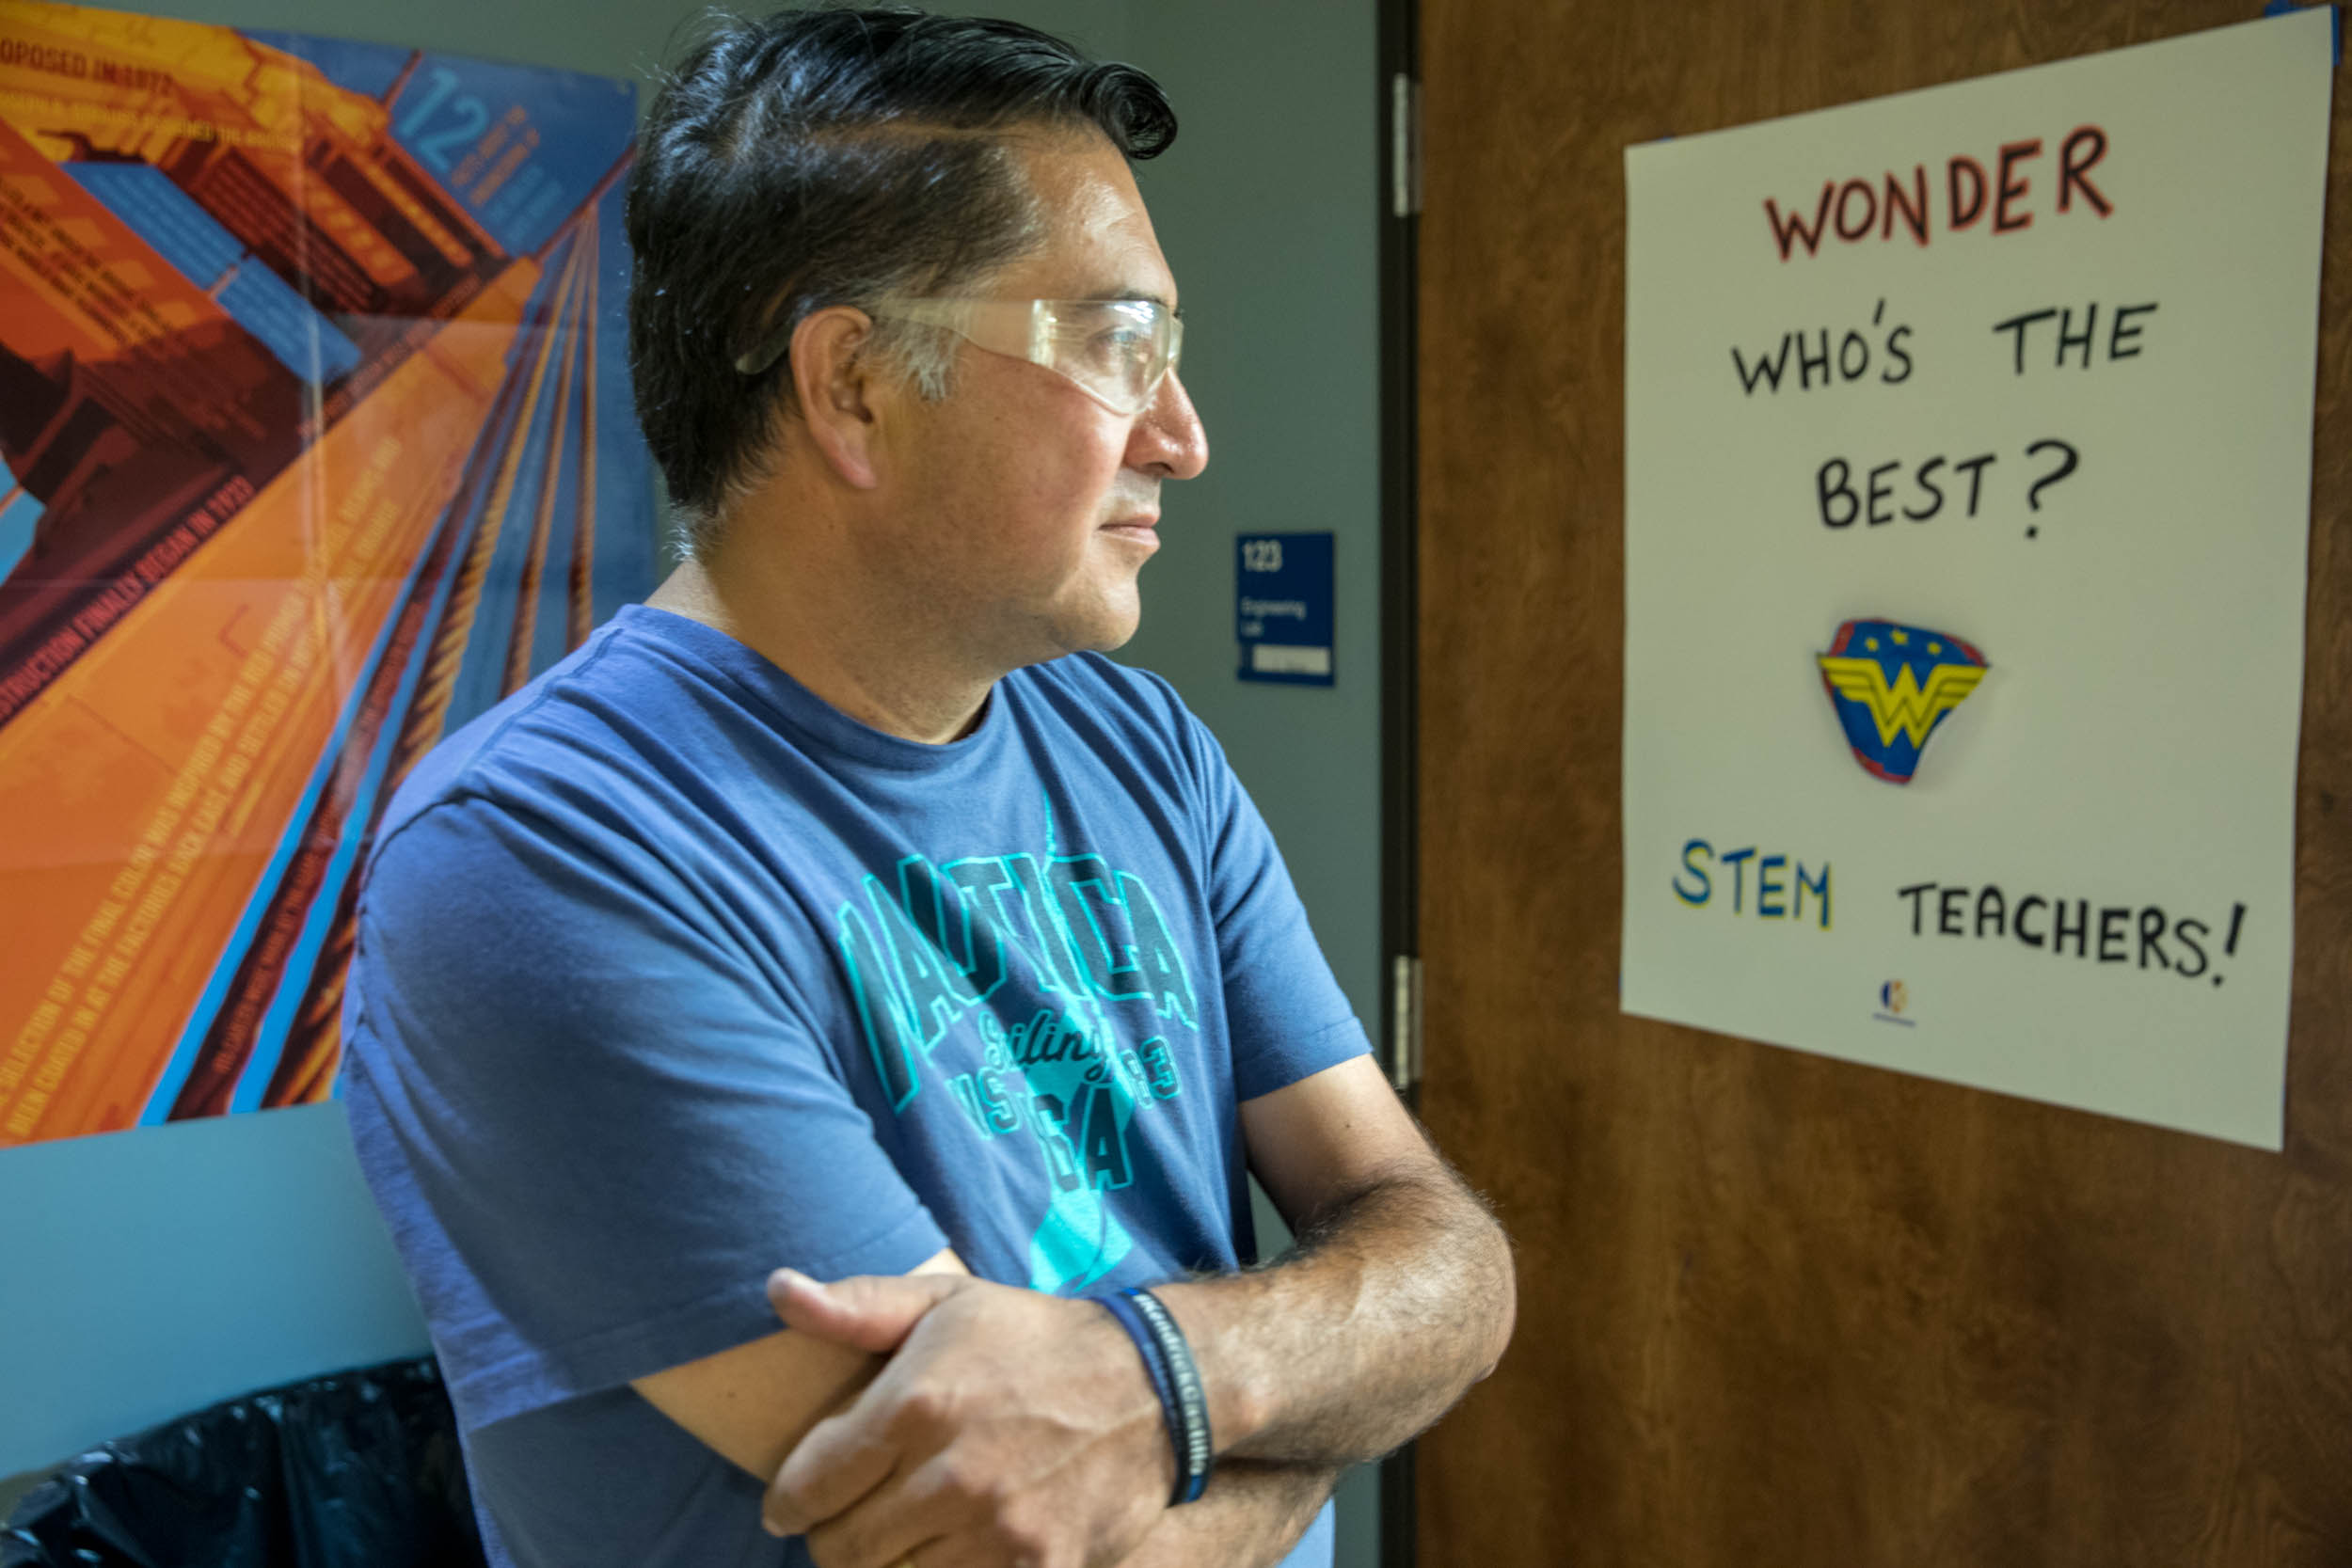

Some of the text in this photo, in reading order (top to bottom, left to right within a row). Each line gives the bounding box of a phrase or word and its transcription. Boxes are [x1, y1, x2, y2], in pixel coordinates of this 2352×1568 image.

[396, 66, 490, 173] 12
[1763, 125, 2114, 262] WONDER
[1731, 298, 2159, 396] WHO'S THE
[72, 571, 146, 641] FINALLY
[186, 507, 216, 539] IN
[1242, 539, 1283, 573] 123
[82, 895, 124, 948] FINAL
[1671, 838, 2247, 989] STEM TEACHERS!
[836, 851, 1200, 1114] NAUTICA
